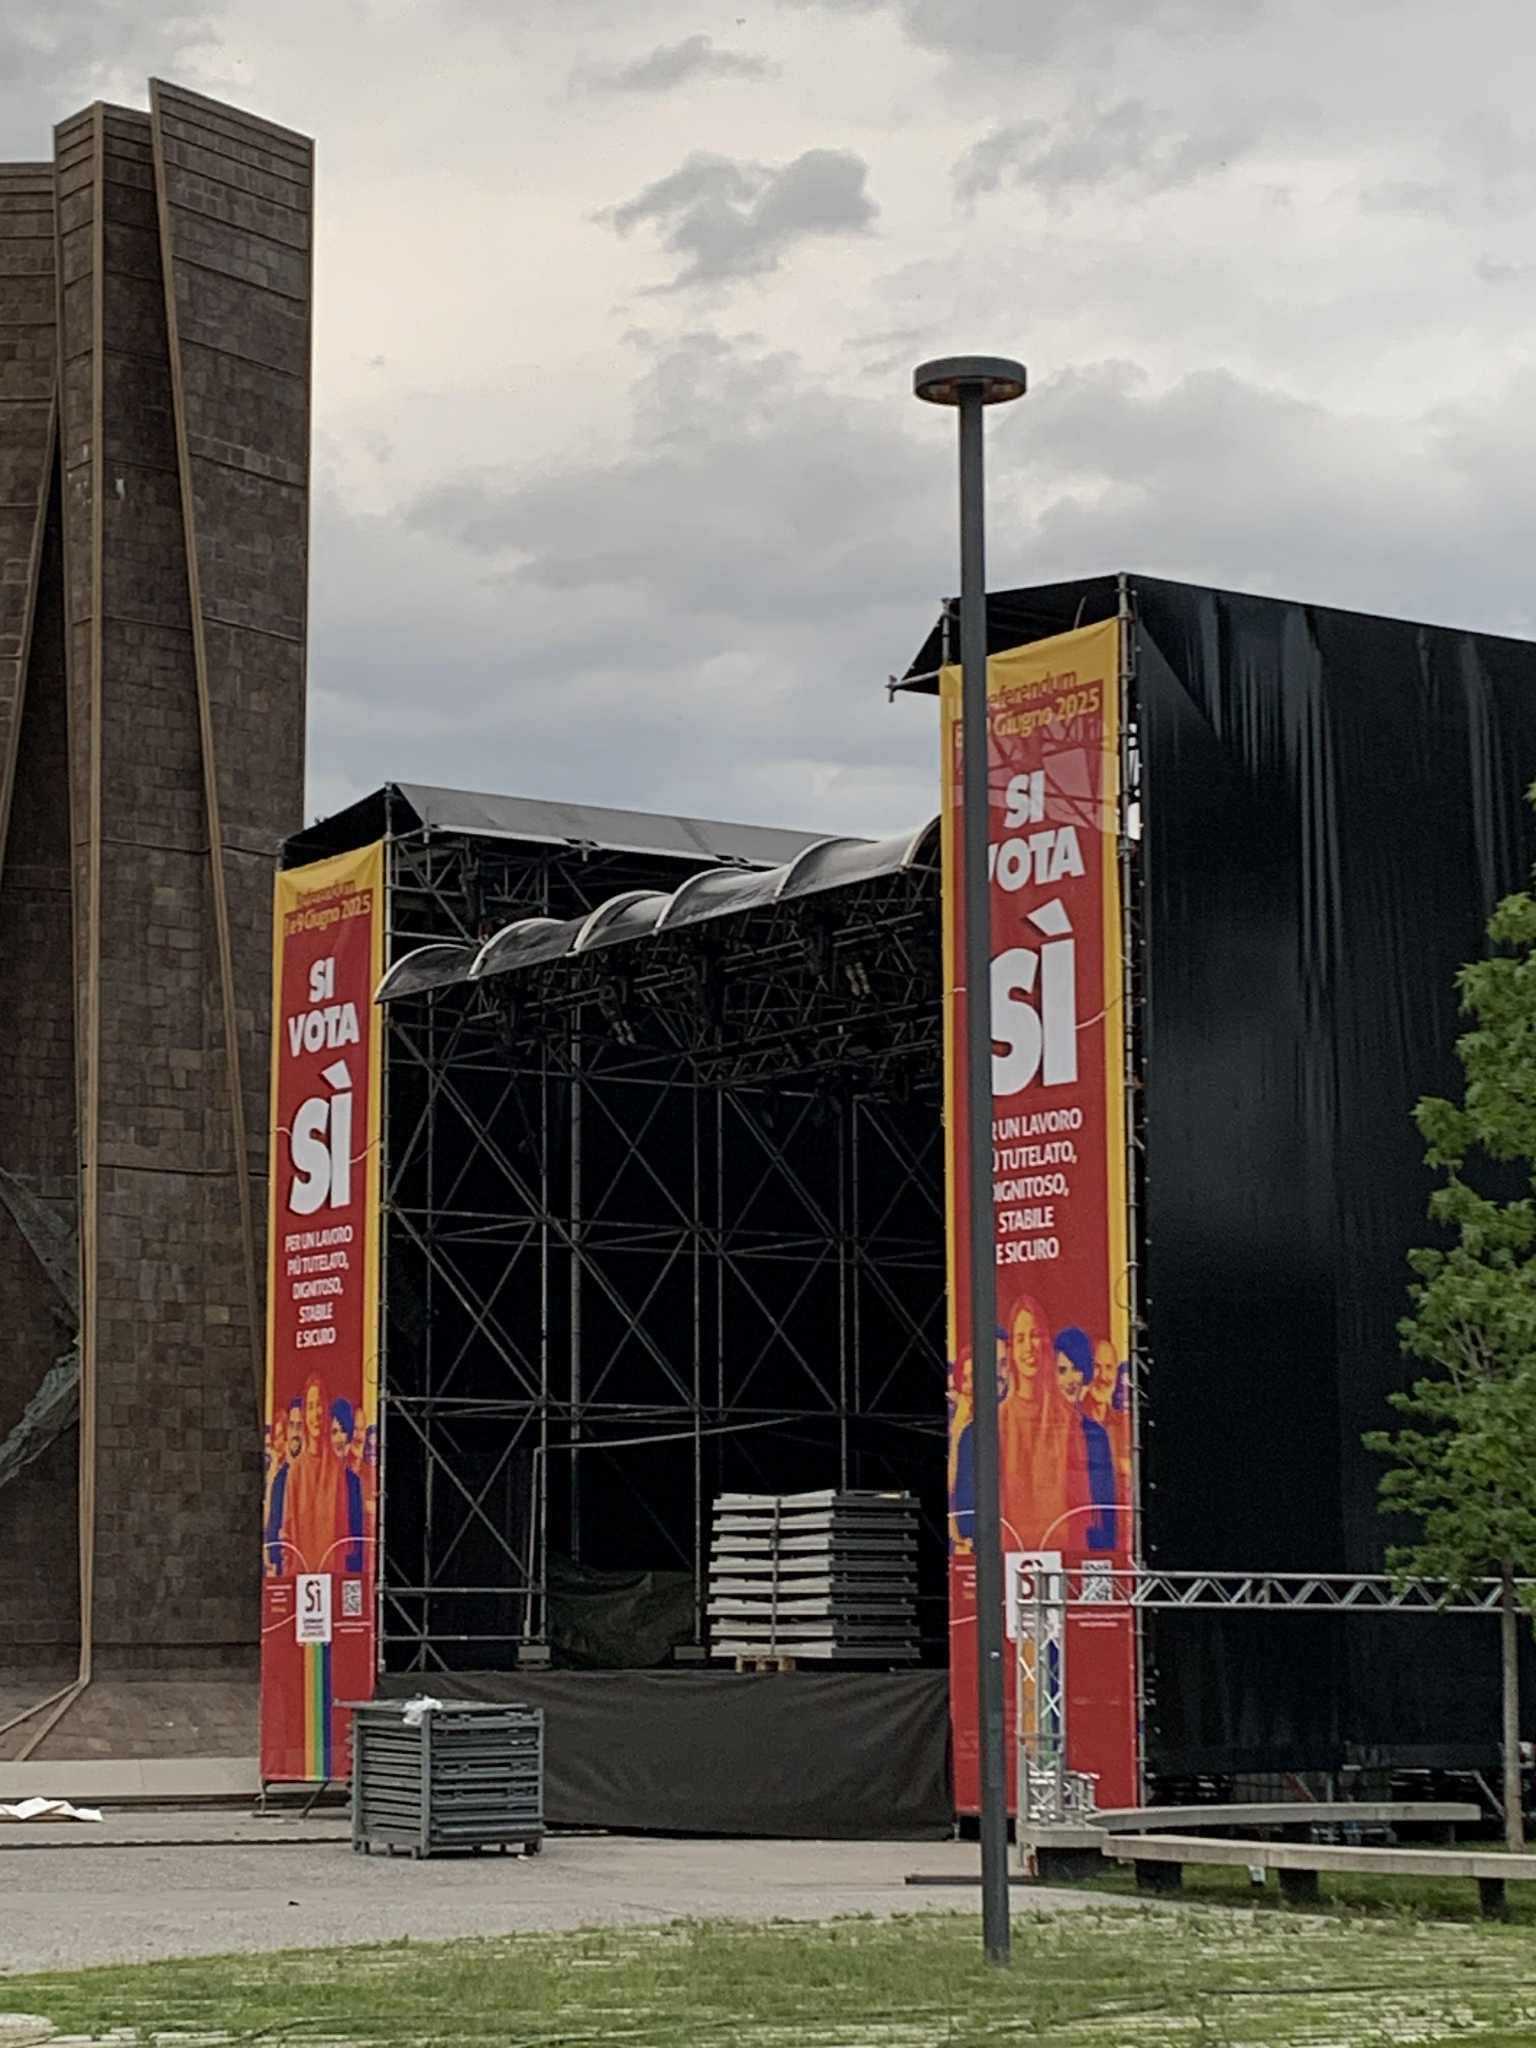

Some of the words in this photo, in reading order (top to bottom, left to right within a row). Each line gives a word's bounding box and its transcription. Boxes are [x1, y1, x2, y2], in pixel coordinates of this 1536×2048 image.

[988, 672, 1077, 709] eferendum
[993, 706, 1052, 738] Giugno
[1055, 687, 1100, 721] 2025
[1003, 769, 1046, 829] SI
[308, 956, 335, 1003] SI
[989, 898, 1078, 1097] SÌ
[287, 1001, 360, 1058] VOTA
[288, 1059, 353, 1216] SÌ
[998, 1118, 1020, 1141] UN
[1022, 1107, 1083, 1137] LAVORO
[1001, 1140, 1078, 1171] TUTELATO,
[998, 1205, 1055, 1234] STABILE
[1005, 1237, 1060, 1264] SICURO
